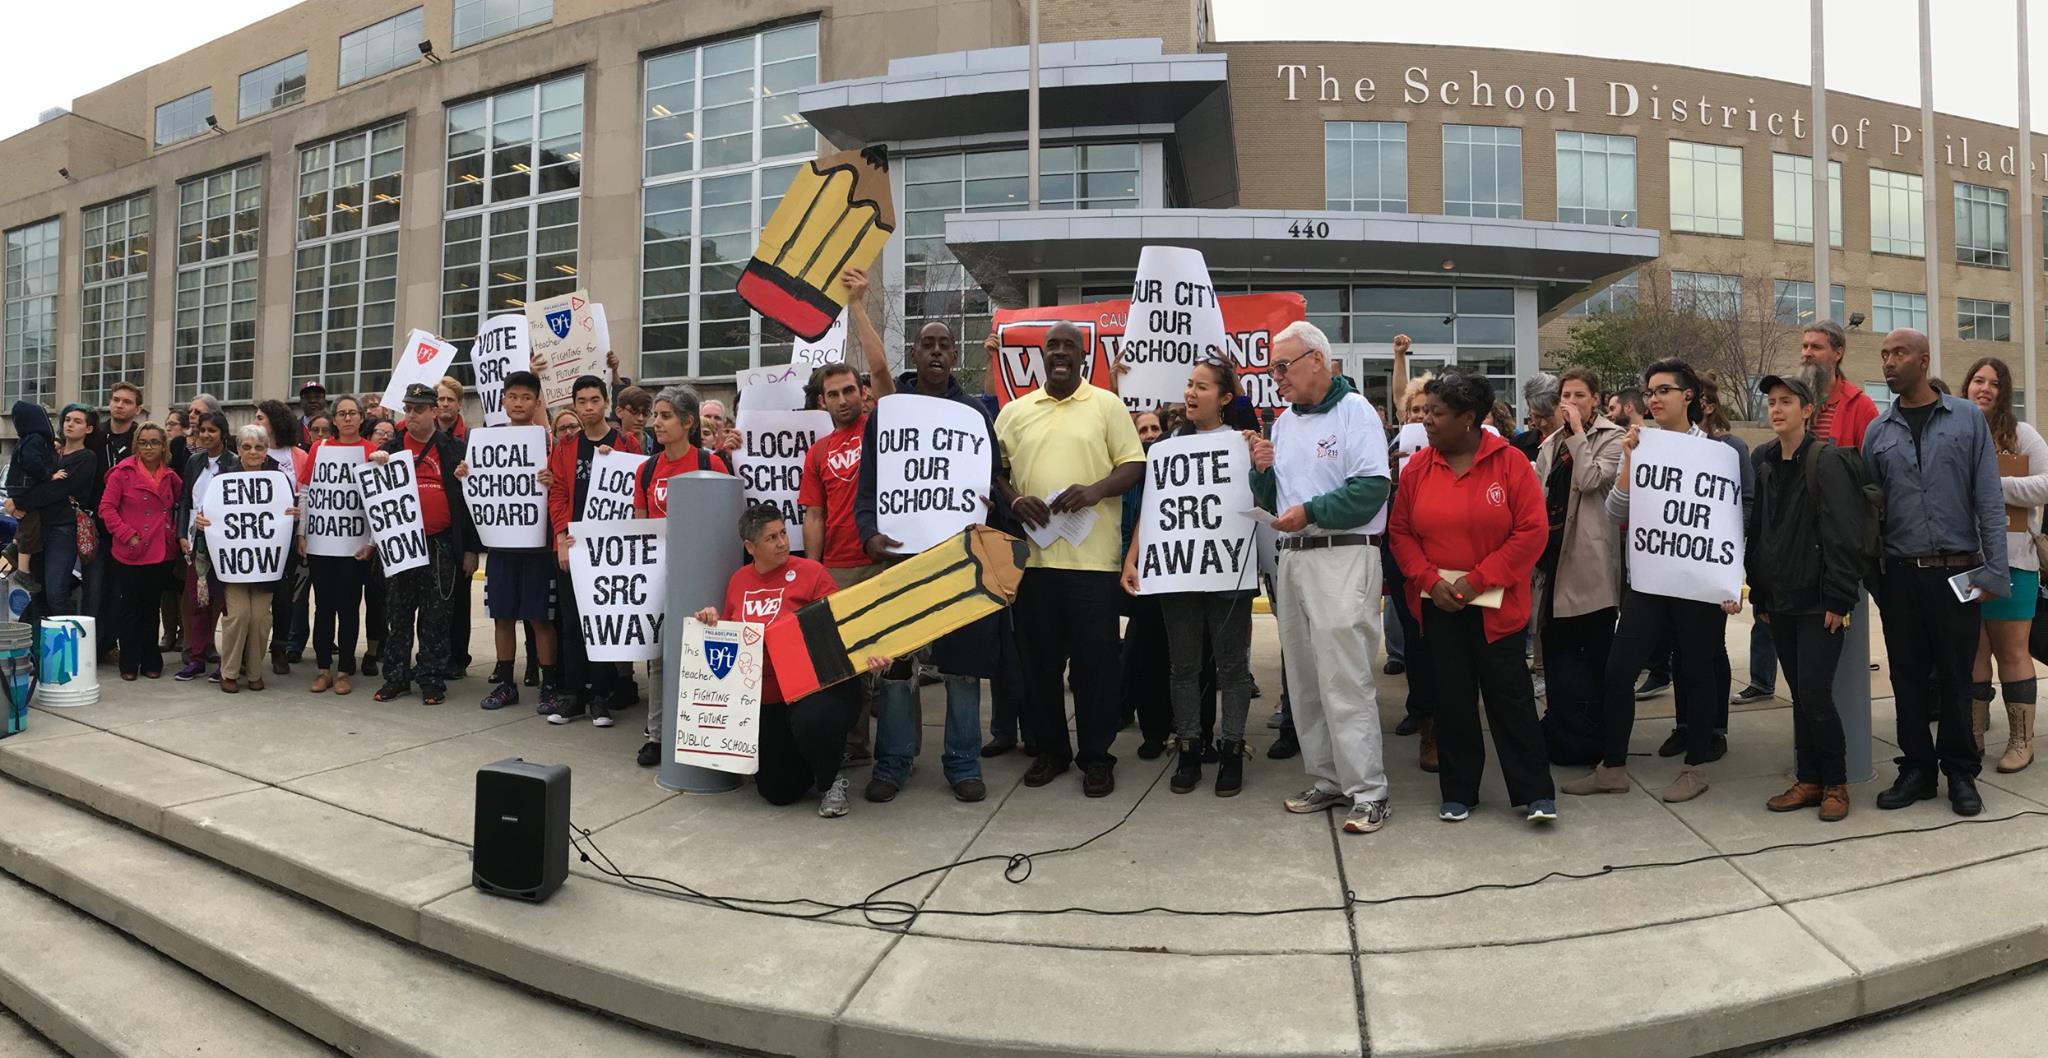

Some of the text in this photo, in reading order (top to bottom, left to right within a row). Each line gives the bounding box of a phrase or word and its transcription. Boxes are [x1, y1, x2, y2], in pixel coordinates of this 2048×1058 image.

[1277, 64, 2048, 182] The School District of Piladl
[1288, 219, 1330, 239] 440
[1174, 280, 1217, 309] CITY
[550, 313, 570, 334] pft
[1100, 313, 1127, 328] CAU
[1149, 309, 1192, 335] OUR
[478, 326, 518, 357] VOTE
[551, 342, 597, 361] FIGHTING for
[480, 356, 511, 385] SRC
[555, 366, 580, 380] FUTURE
[545, 385, 573, 399] PUBLIC
[879, 427, 984, 455] OUR CITY
[471, 443, 535, 468] LOCAL
[904, 456, 950, 482] OUR
[359, 459, 410, 500] END
[598, 467, 636, 497] LOC
[739, 464, 804, 492] SCHO
[1152, 450, 1231, 490] VOTE
[222, 478, 273, 505] END
[467, 473, 543, 498] SCHOOL
[1635, 463, 1740, 506] OUR CITY
[368, 493, 417, 533] SRC
[472, 503, 539, 526] BOARD
[587, 496, 636, 521] SCHO
[878, 486, 976, 515] SCHOOLS
[1159, 493, 1223, 531] SRC
[1663, 499, 1711, 530] OUR
[224, 511, 275, 540] SRC
[308, 514, 365, 537] BOARD
[376, 528, 427, 568] NOW
[585, 533, 658, 567] VOTE
[1142, 538, 1245, 579] AWAY
[1634, 527, 1735, 565] SCHOOLS
[218, 546, 282, 575] NOW
[593, 573, 647, 606] SRC
[582, 613, 665, 646] AWAY
[705, 630, 738, 638] PHILADELPHIA
[684, 643, 700, 657] This
[709, 646, 734, 671] pft
[681, 667, 713, 682] teacher
[680, 688, 756, 706] is FIGHTING for
[680, 710, 751, 727] the FUTURE of
[677, 729, 757, 755] PUBLIC SCHOOLS
